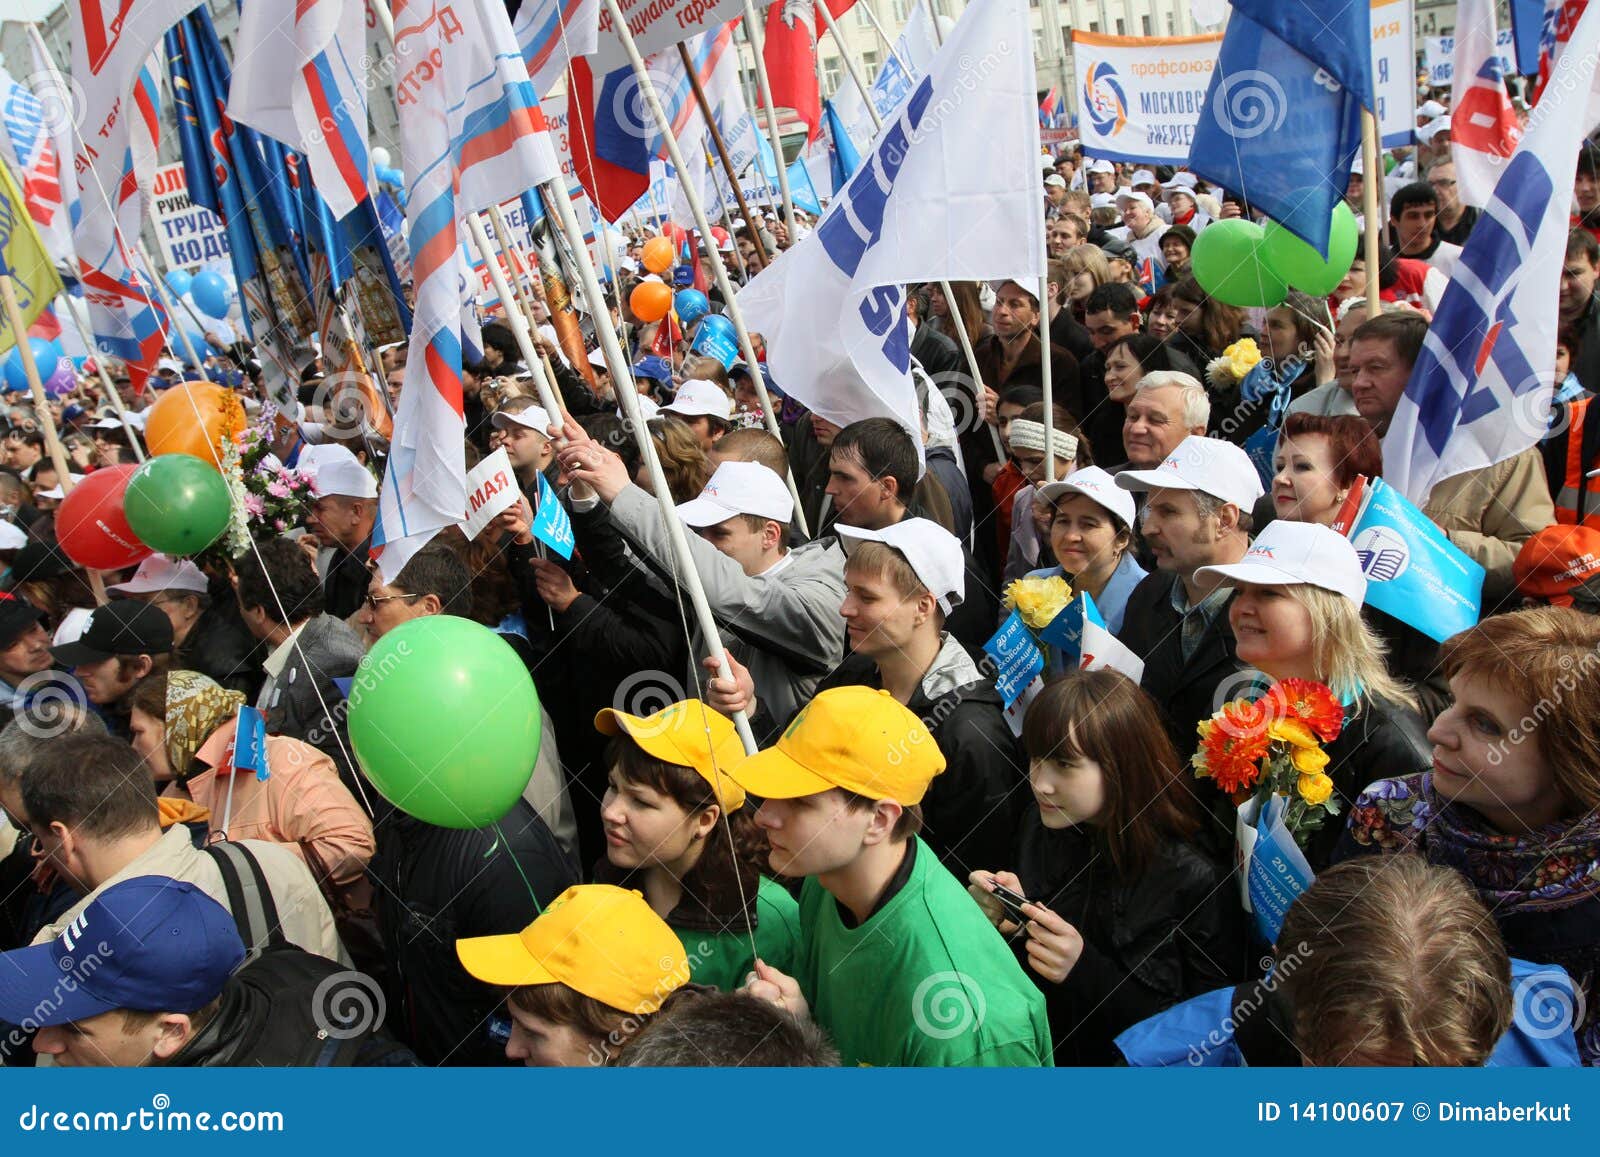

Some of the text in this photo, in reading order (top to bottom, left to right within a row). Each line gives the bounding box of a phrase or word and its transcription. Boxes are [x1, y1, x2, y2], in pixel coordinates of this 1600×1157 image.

[469, 470, 509, 512] МАЯ
[997, 637, 1028, 670] СКОВСКАЯ
[1271, 856, 1288, 874] 20
